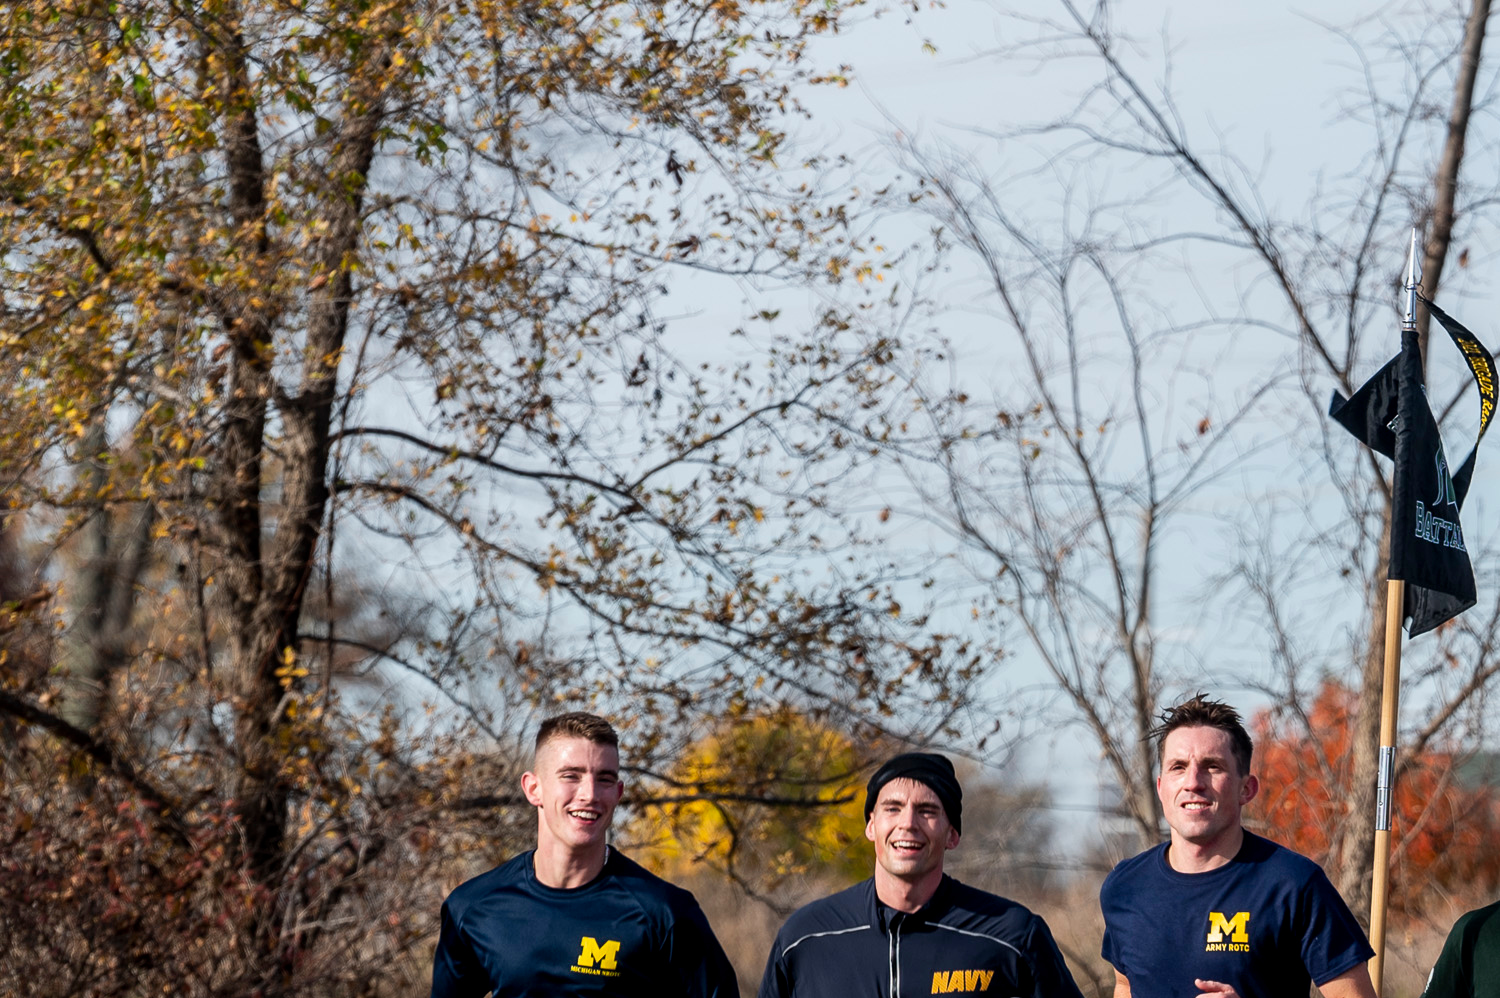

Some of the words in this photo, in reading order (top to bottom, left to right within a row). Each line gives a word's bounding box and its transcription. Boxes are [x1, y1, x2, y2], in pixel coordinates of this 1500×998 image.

[1207, 911, 1251, 943] M
[577, 936, 621, 970] M
[1205, 943, 1227, 952] ARMY
[1228, 943, 1250, 953] ROTC
[570, 964, 601, 976] MICHIGAN
[930, 969, 995, 995] NAVY
